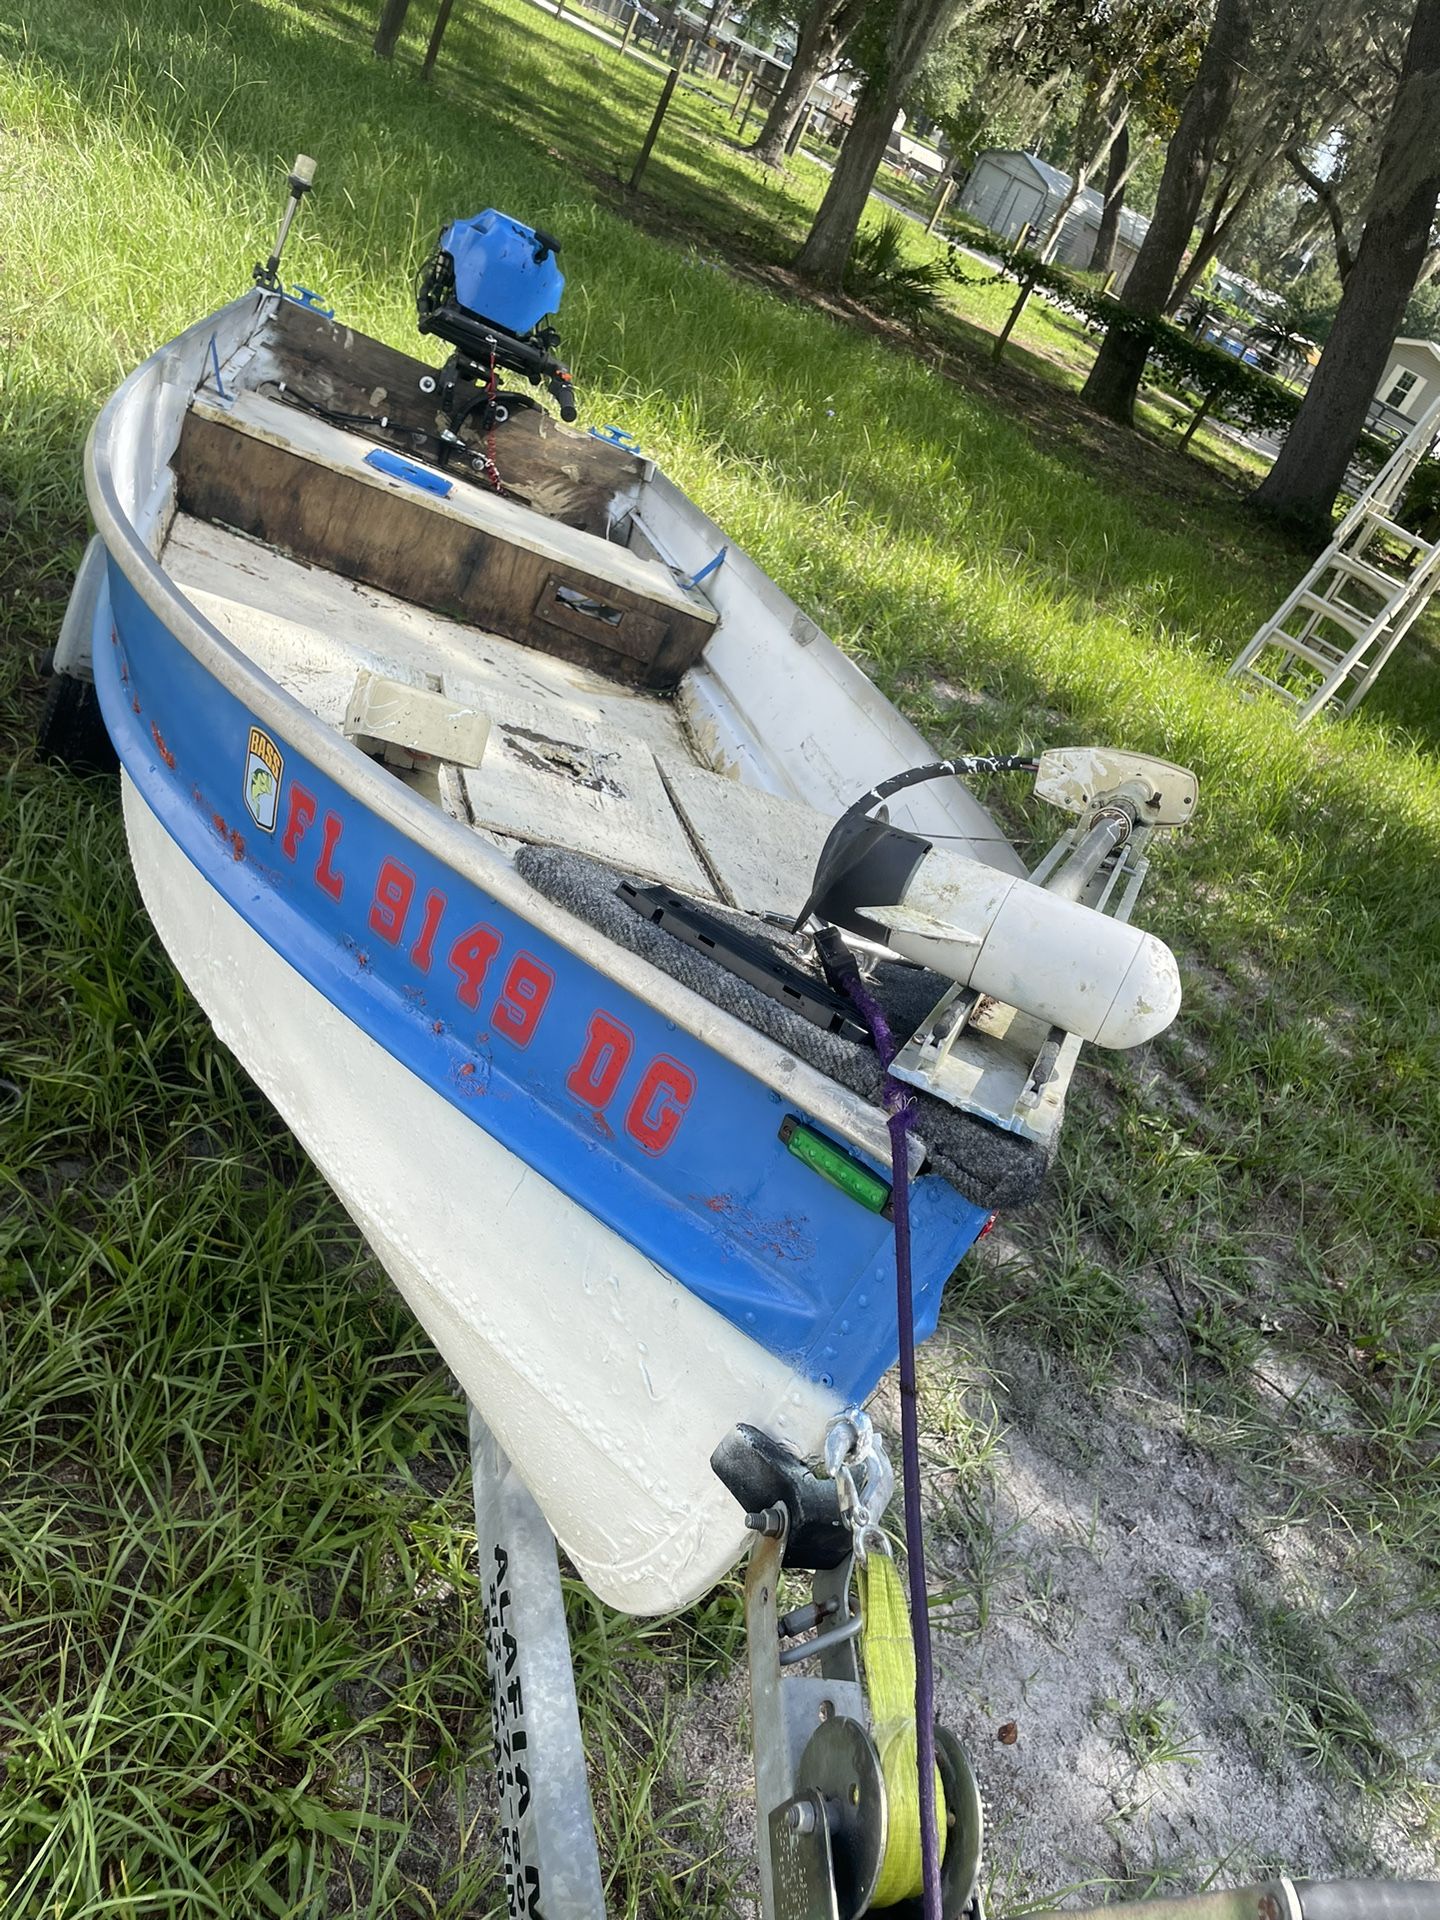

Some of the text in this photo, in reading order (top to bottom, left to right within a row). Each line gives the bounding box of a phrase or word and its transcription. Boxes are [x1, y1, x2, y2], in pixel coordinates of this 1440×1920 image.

[250, 730, 281, 779] BASS
[282, 780, 697, 1158] FL 9149 DG
[494, 1543, 530, 1818] ALAFIA
